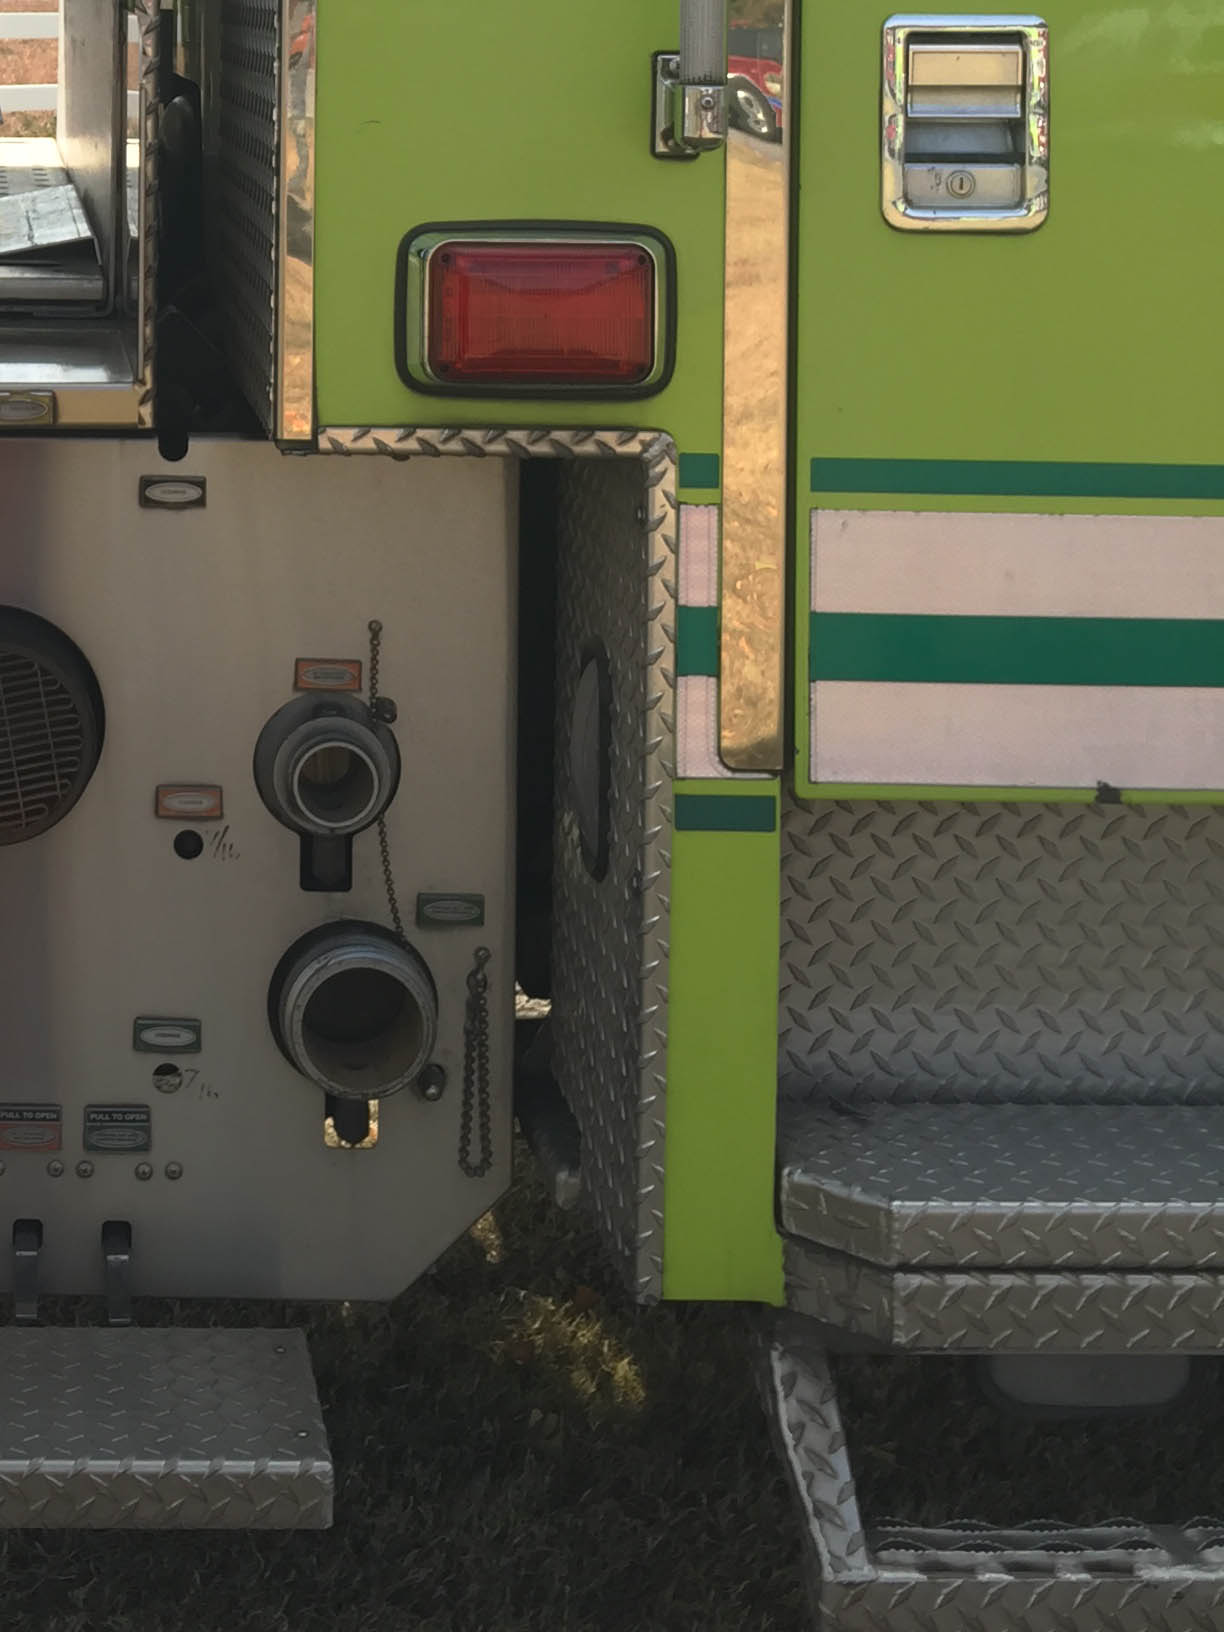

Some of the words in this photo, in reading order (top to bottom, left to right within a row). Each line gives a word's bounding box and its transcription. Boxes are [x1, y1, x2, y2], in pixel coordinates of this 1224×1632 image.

[0, 1111, 21, 1120] PULL
[22, 1111, 34, 1120] TO
[34, 1111, 57, 1120] OPEN
[89, 1112, 110, 1121] PULL
[111, 1112, 123, 1121] TO
[124, 1112, 147, 1121] OPEN
